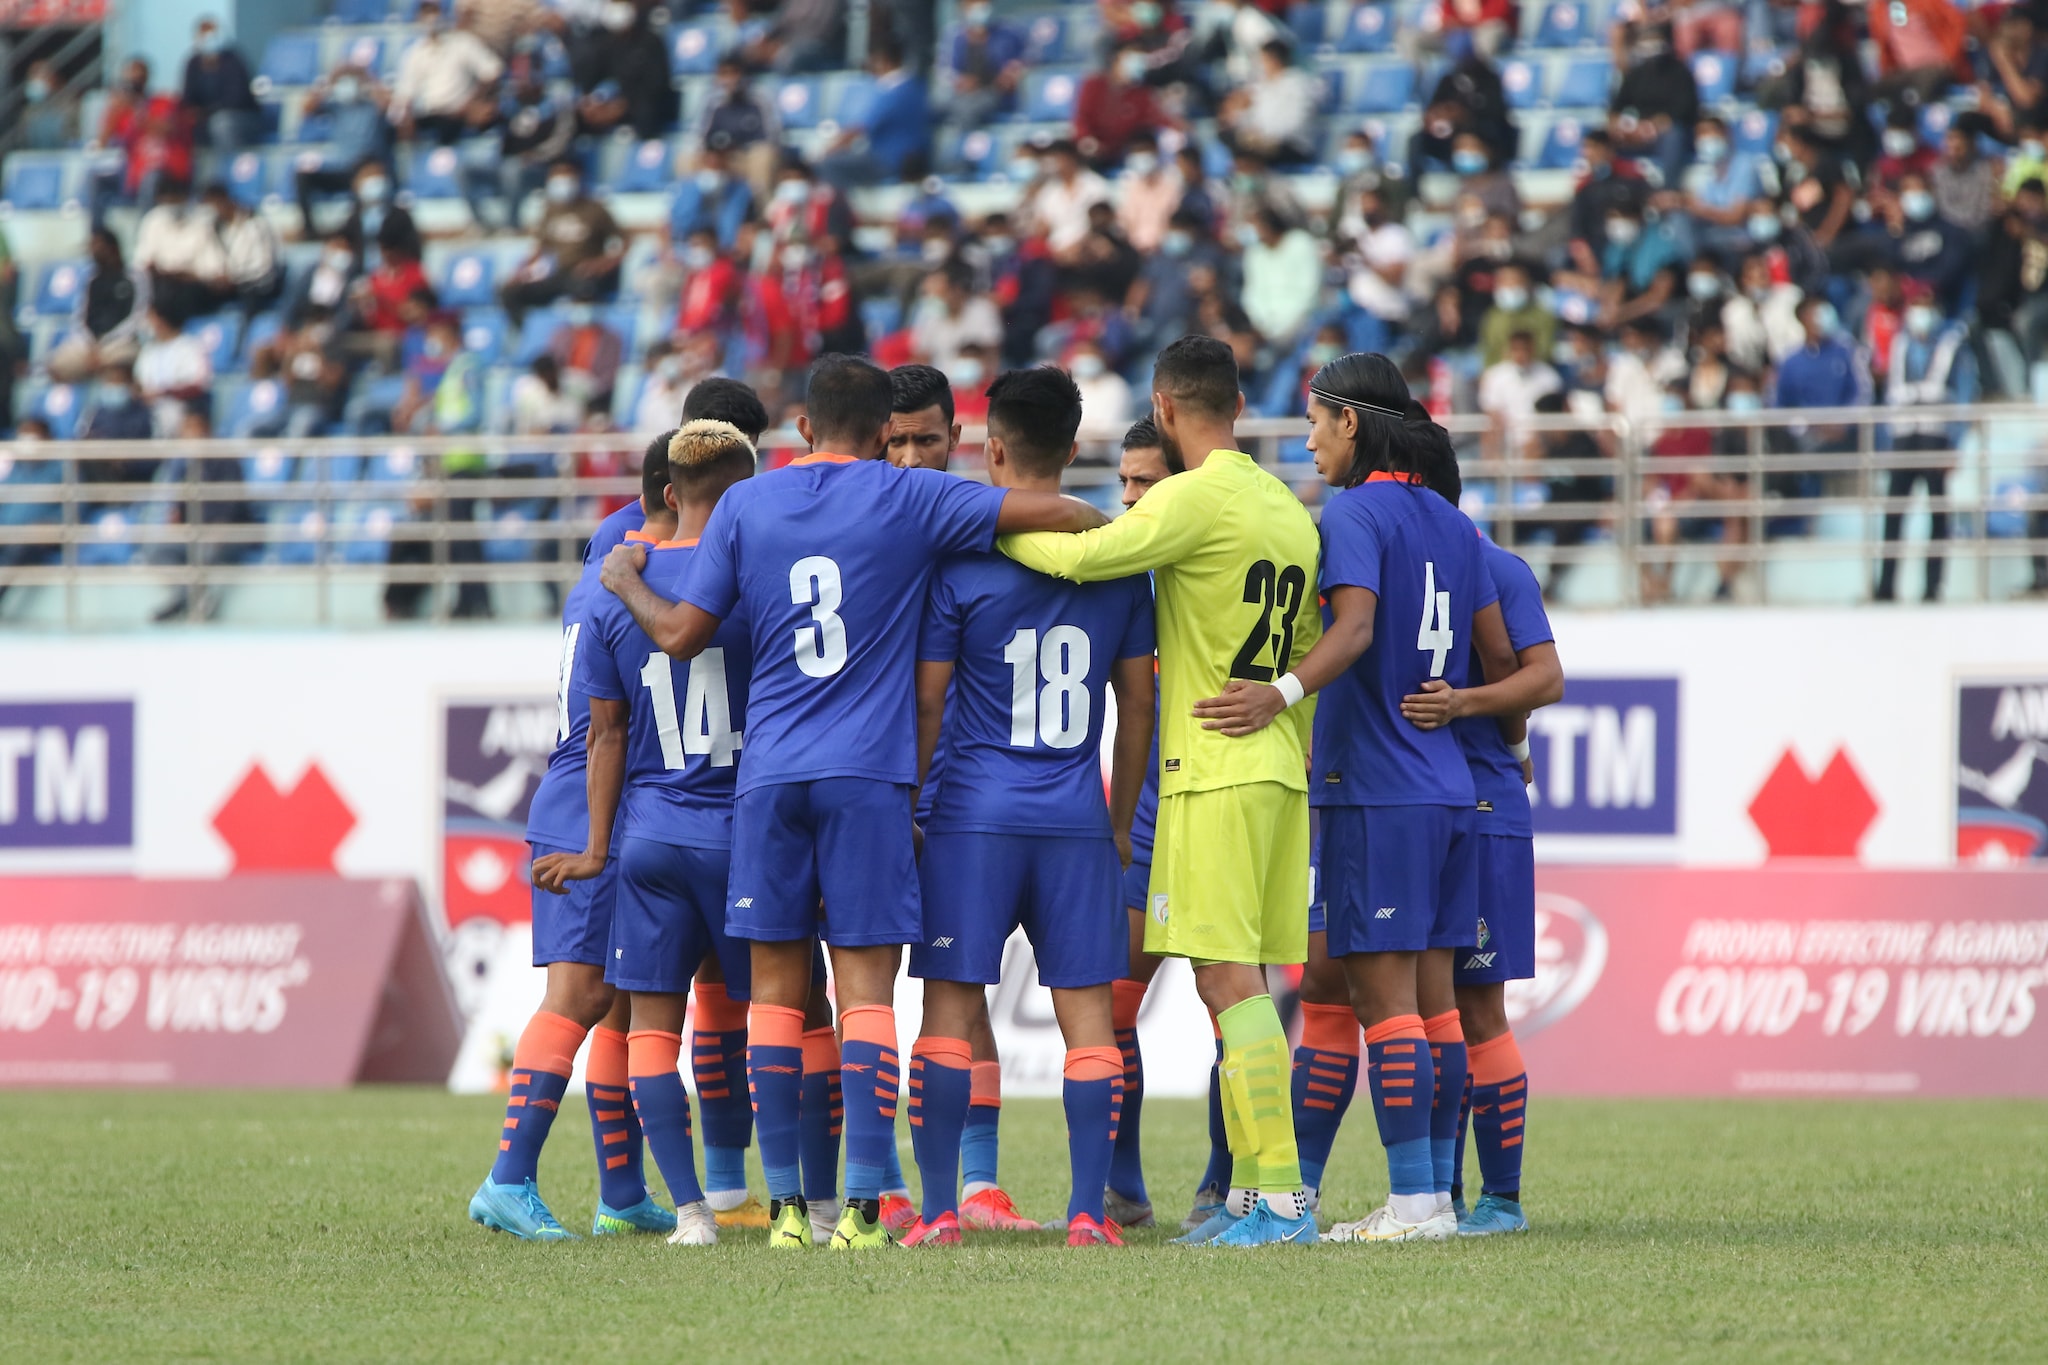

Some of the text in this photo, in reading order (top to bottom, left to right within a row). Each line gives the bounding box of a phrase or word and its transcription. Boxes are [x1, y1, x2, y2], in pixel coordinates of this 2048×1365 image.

[789, 555, 848, 678] 3
[1229, 559, 1306, 682] 23
[1417, 561, 1454, 678] 4
[639, 646, 743, 770] 14
[1003, 624, 1091, 750] 18
[0, 966, 140, 1032] ID-19
[46, 922, 176, 966] EFFECTIVE
[178, 922, 303, 965] AGAINST
[1684, 918, 1798, 962] PROVEN
[1798, 919, 1932, 964] EFFECTIVE
[1655, 965, 1889, 1037] COVID-19
